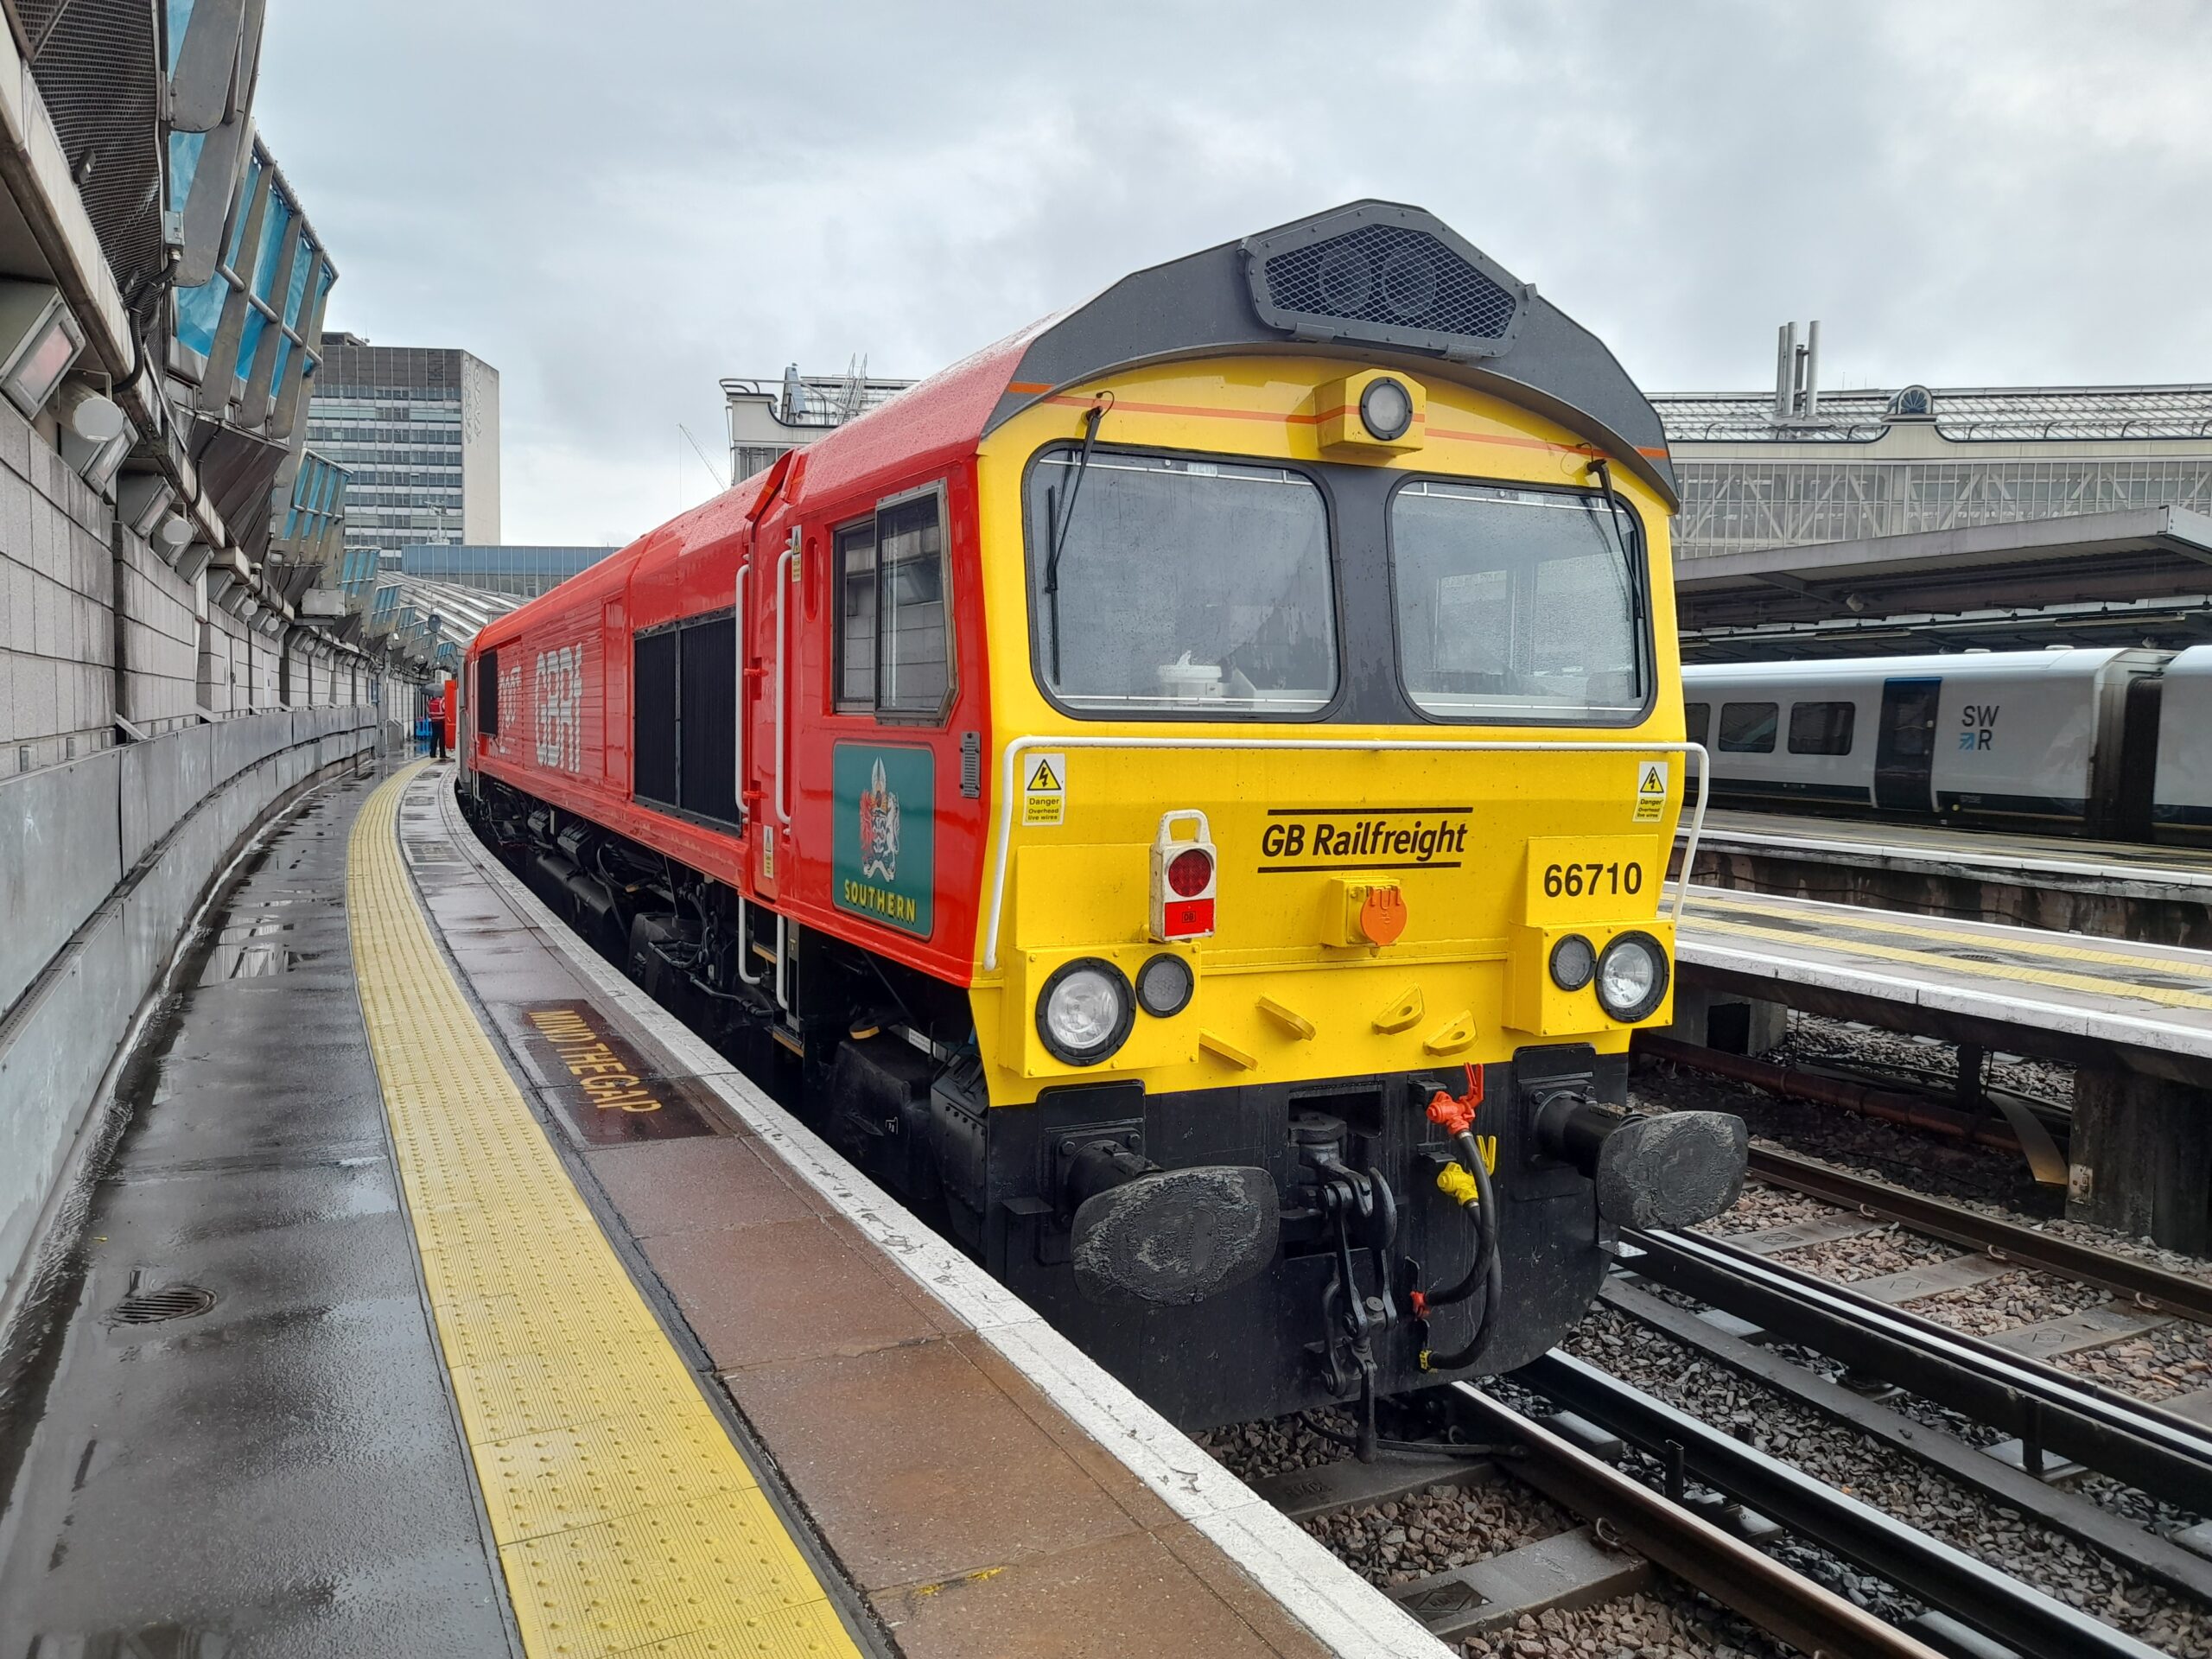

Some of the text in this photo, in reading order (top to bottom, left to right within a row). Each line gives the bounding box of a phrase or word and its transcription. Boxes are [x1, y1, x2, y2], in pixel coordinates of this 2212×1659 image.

[1961, 705, 2000, 727] SW
[1977, 729, 1993, 751] R
[1029, 798, 1059, 806] Danger
[1262, 820, 1469, 862] GB Railfreight
[1543, 861, 1643, 898] 66710
[844, 878, 916, 924] SOUTHERN
[528, 1010, 663, 1113] MIND THE GAP
